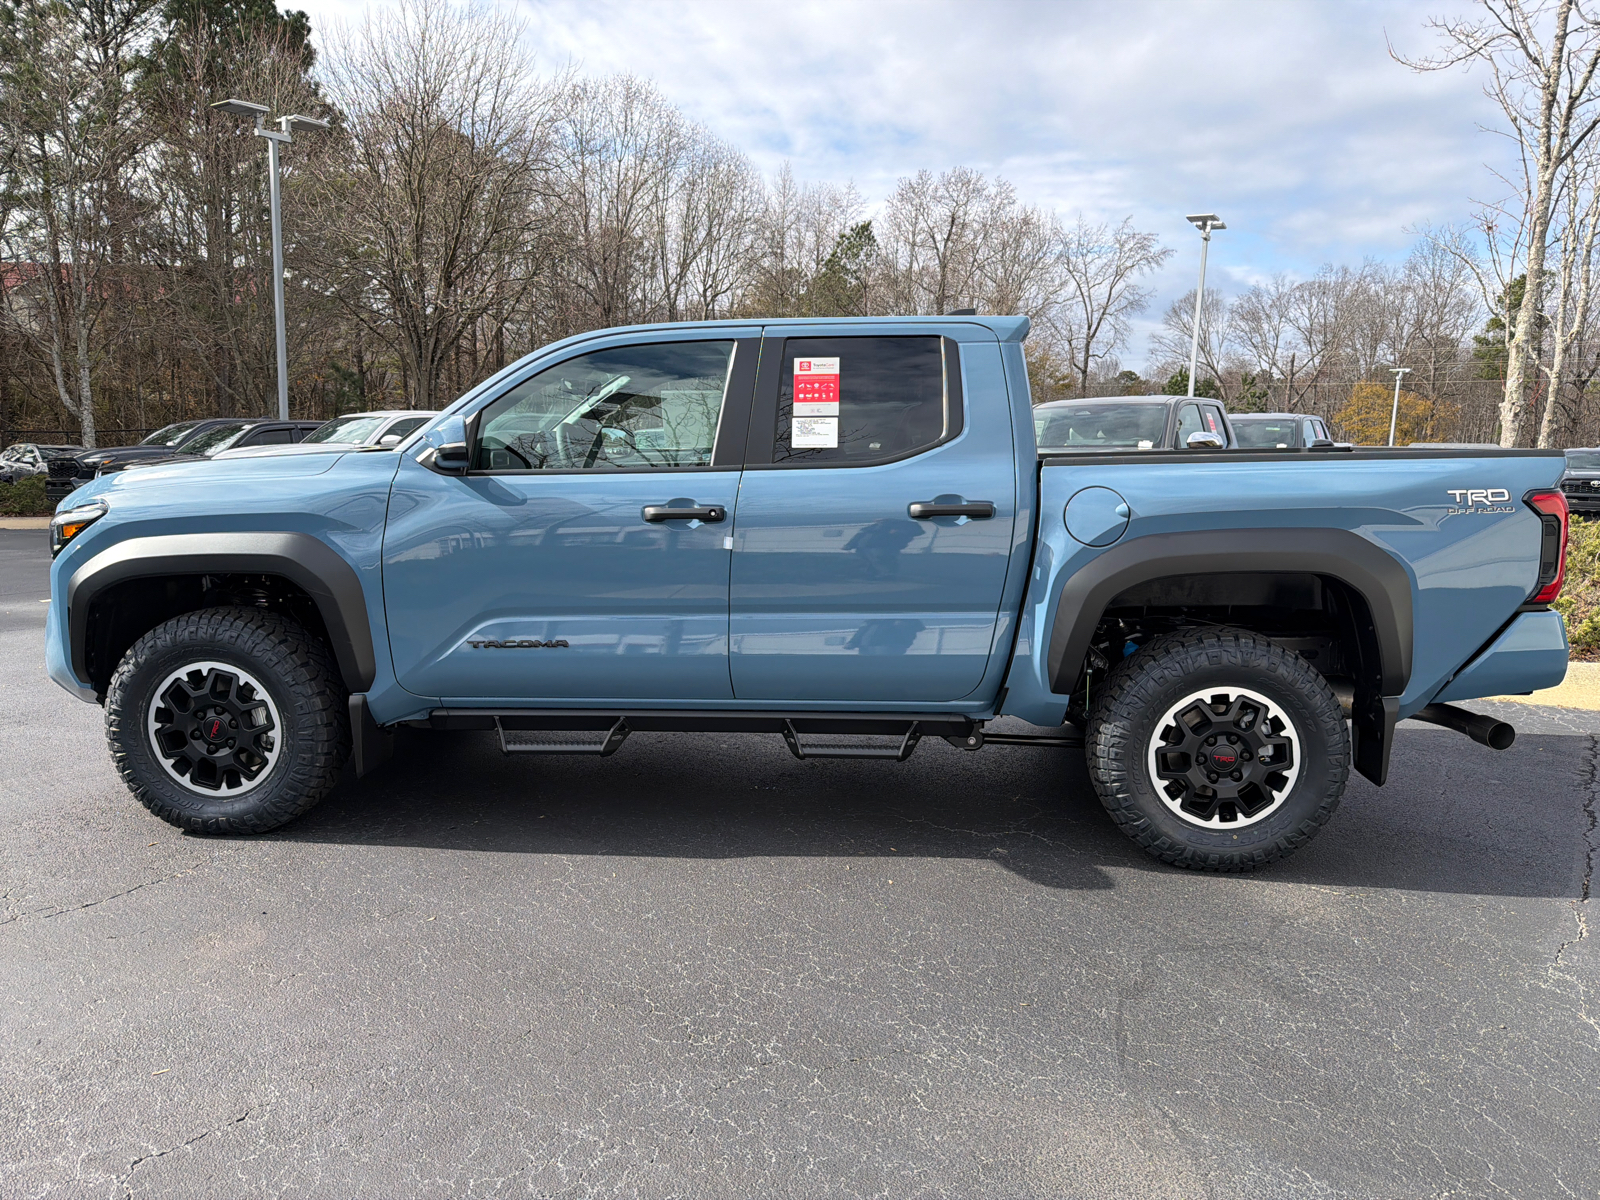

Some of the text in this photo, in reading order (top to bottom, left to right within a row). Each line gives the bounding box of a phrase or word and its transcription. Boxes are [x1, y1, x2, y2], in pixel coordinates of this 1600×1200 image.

[1447, 488, 1512, 506] TRD
[1477, 506, 1516, 514] ROAD
[467, 639, 569, 648] TACOMA
[210, 720, 220, 738] TRD
[1213, 755, 1235, 763] TRD
